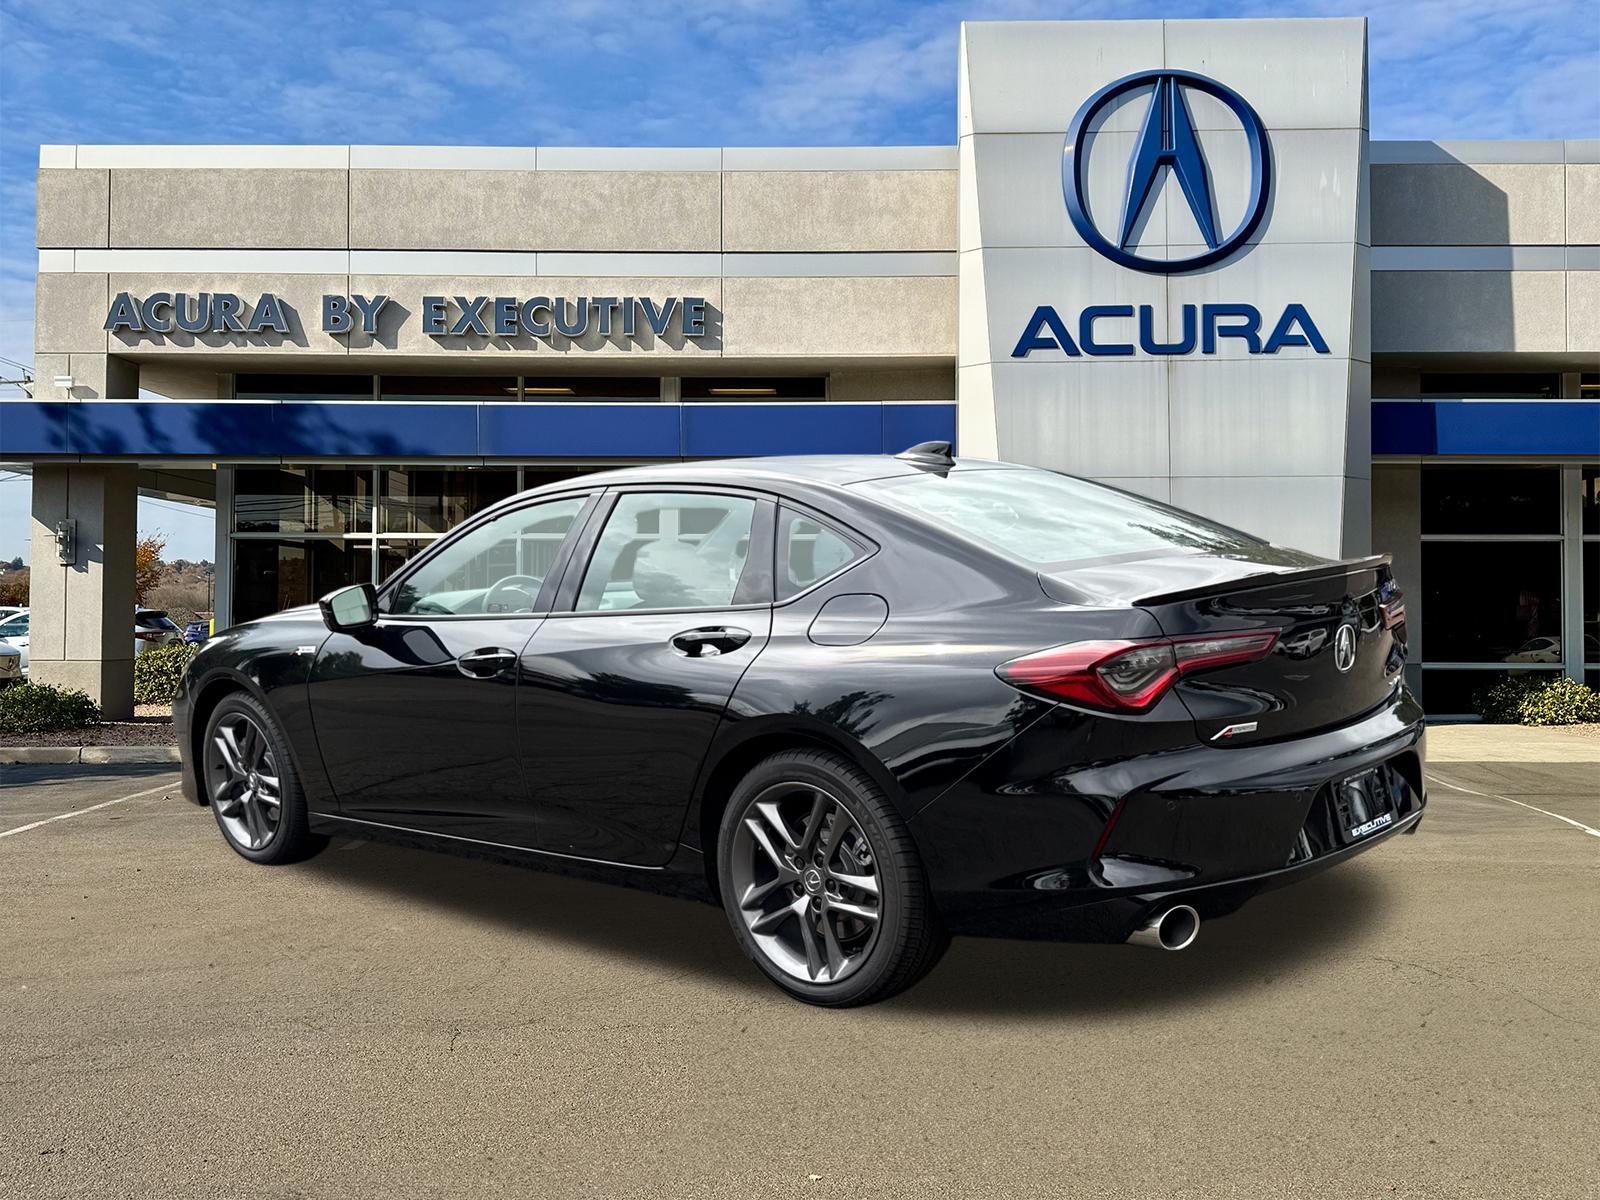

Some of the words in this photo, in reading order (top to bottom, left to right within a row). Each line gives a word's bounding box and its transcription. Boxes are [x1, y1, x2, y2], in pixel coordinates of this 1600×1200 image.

[103, 291, 289, 335] ACURA
[322, 294, 391, 335] BY
[422, 295, 706, 338] EXECUTIVE
[1010, 303, 1332, 358] ACURA
[1351, 813, 1392, 837] EXECUTIVE
